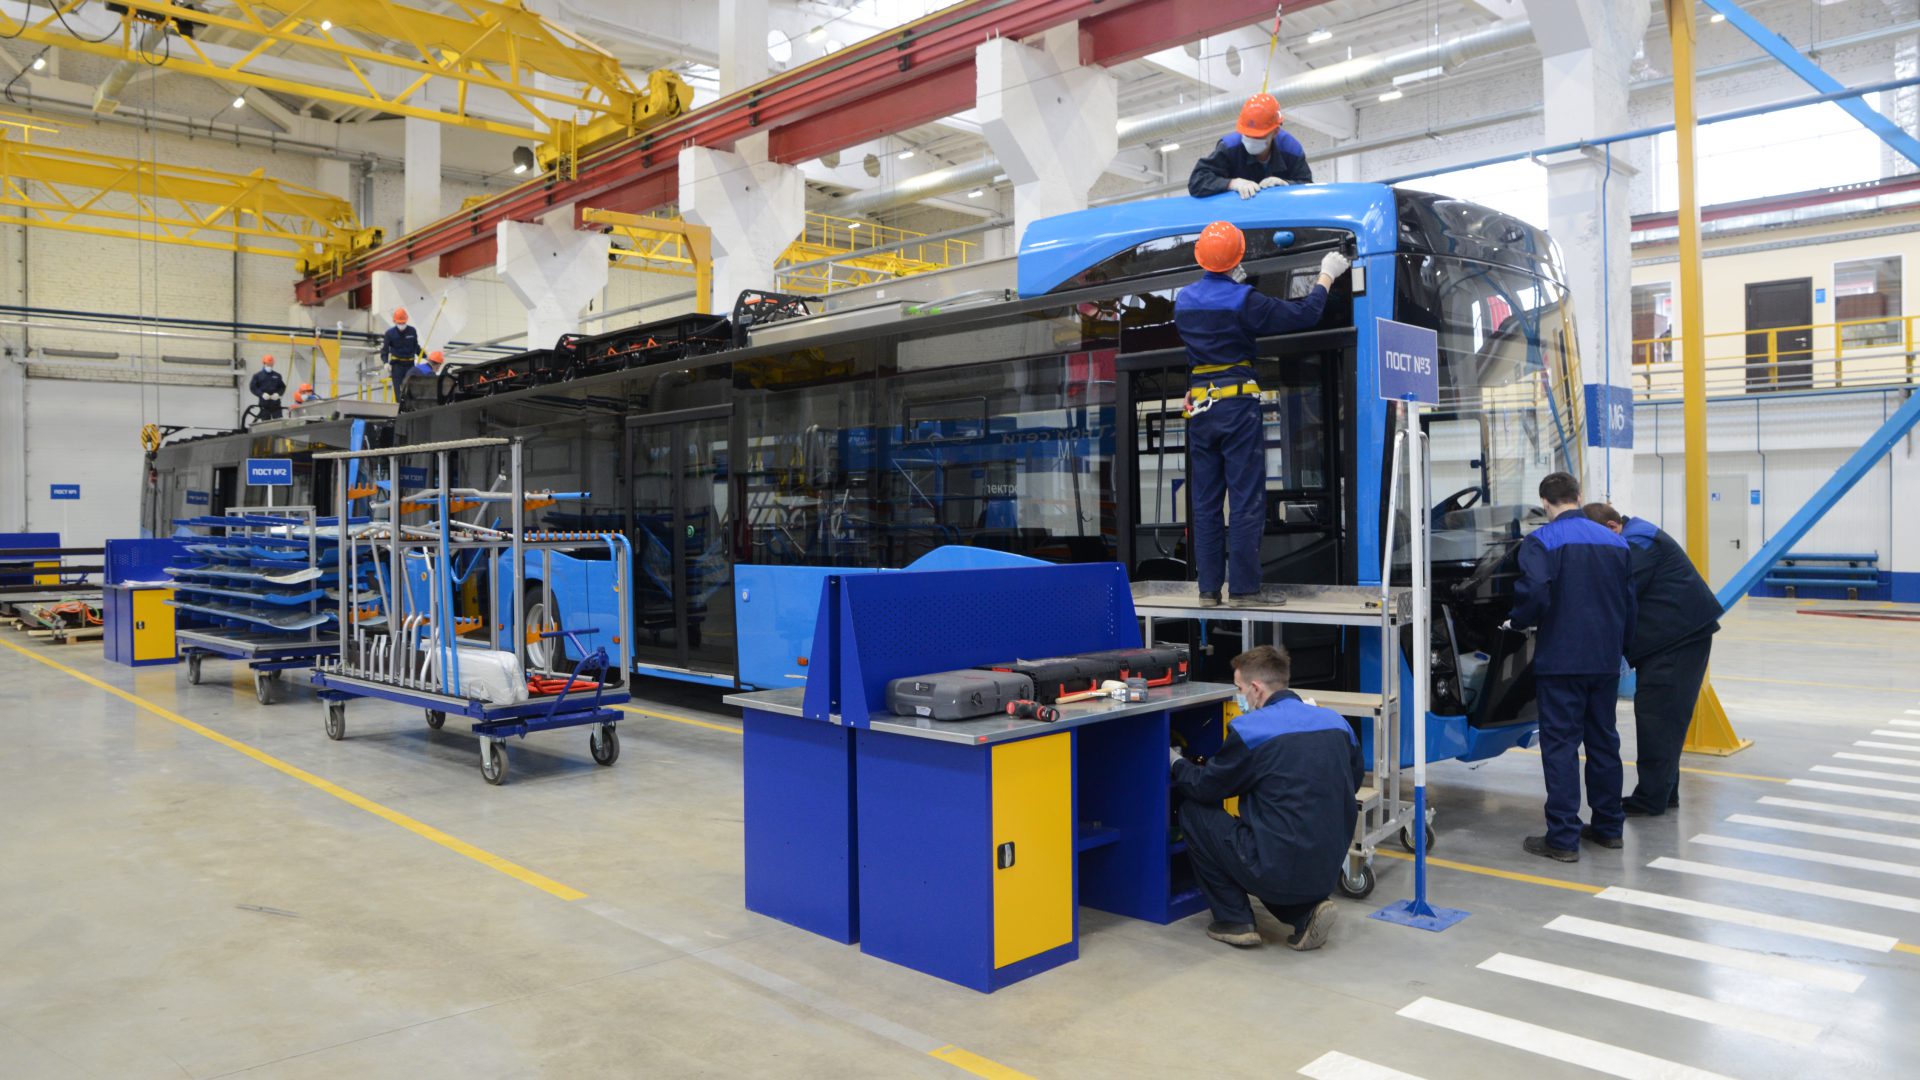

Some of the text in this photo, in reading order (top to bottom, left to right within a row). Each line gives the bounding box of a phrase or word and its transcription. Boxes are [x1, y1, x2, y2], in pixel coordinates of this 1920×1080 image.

[1385, 350, 1431, 375] ПОСТ №3
[1608, 403, 1625, 431] М6
[252, 468, 272, 476] ПОСТ
